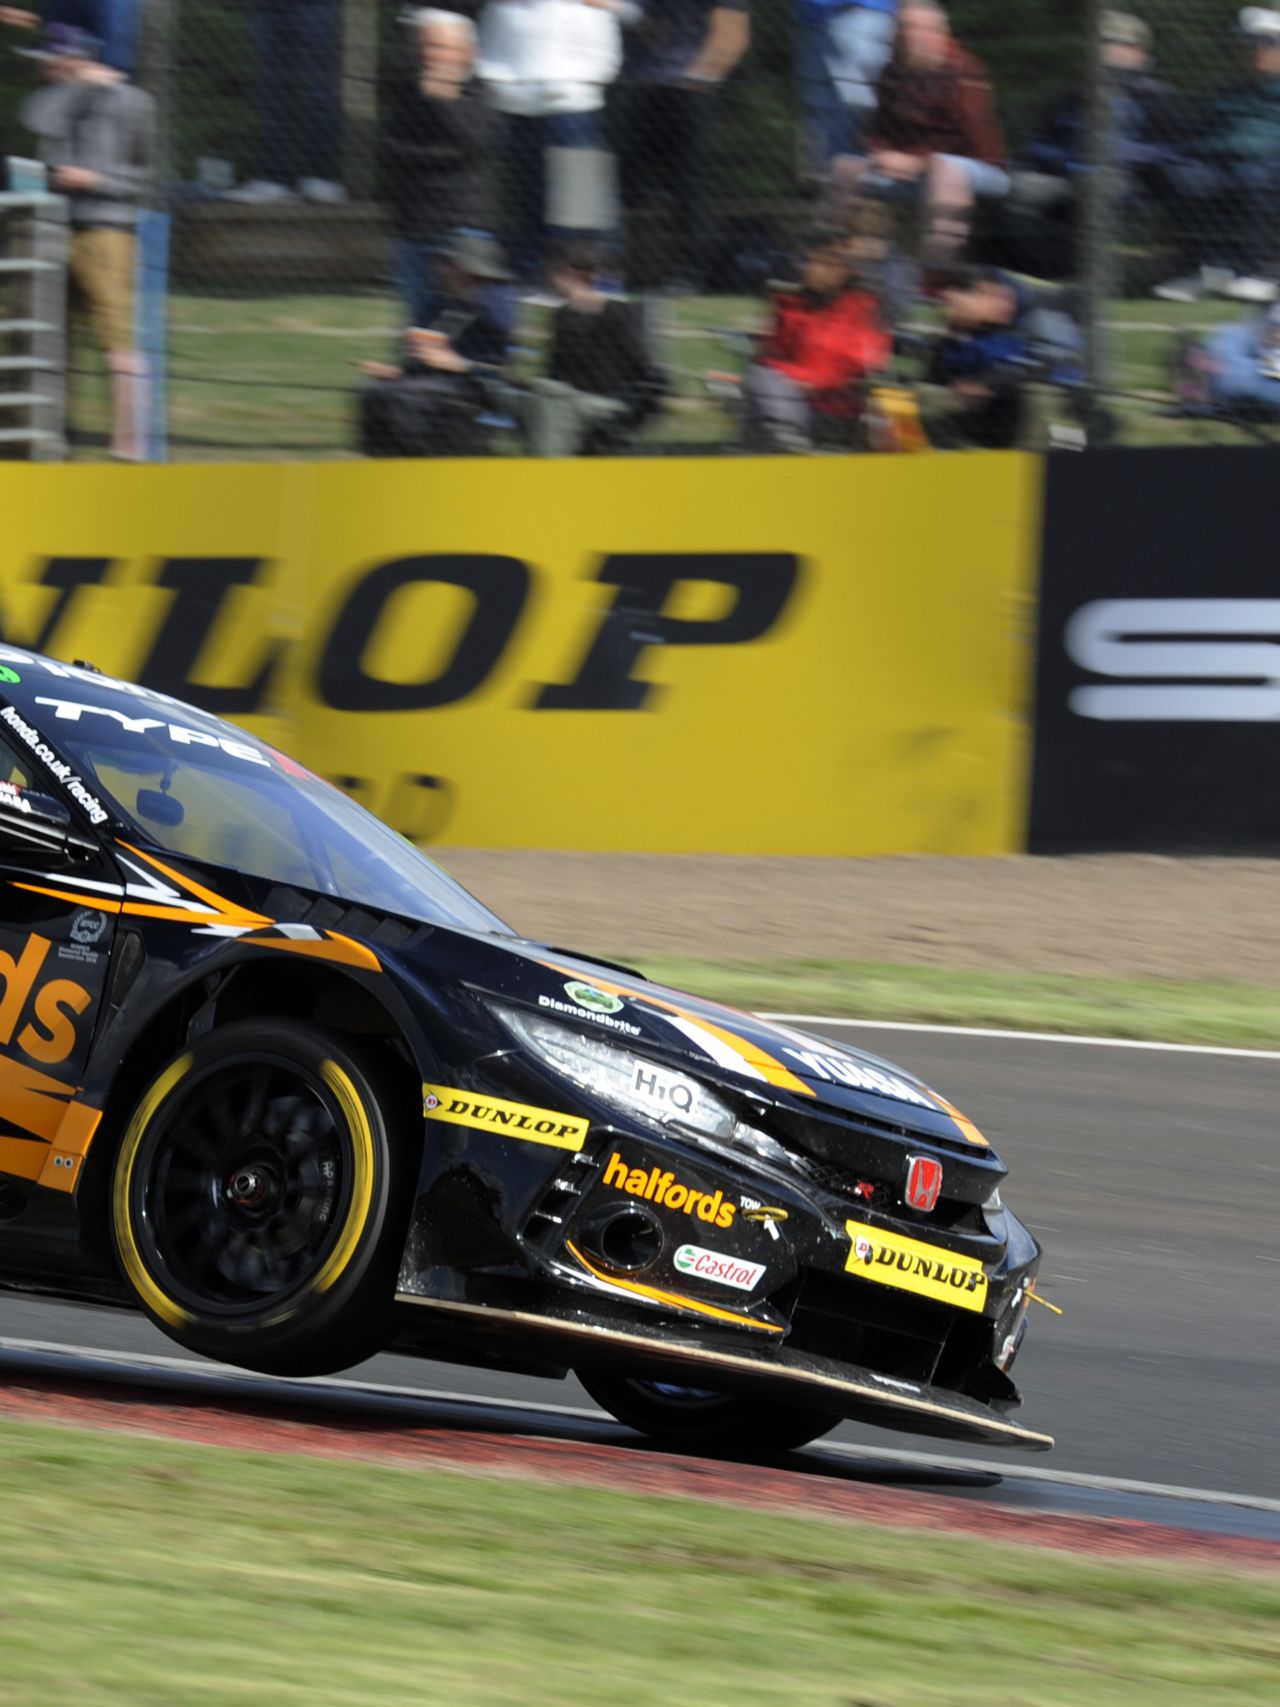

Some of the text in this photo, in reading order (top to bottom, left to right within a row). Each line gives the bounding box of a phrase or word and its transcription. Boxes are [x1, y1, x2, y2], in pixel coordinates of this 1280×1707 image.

[35, 696, 271, 767] TYPE
[0, 706, 108, 824] honda.co.uk/racing
[538, 995, 641, 1036] Diamondbrite
[445, 1099, 581, 1139] DUNLOP
[602, 1152, 737, 1228] halfords
[740, 1196, 761, 1211] TOW
[693, 1255, 758, 1286] Castrol
[874, 1246, 985, 1292] DUNLOP
